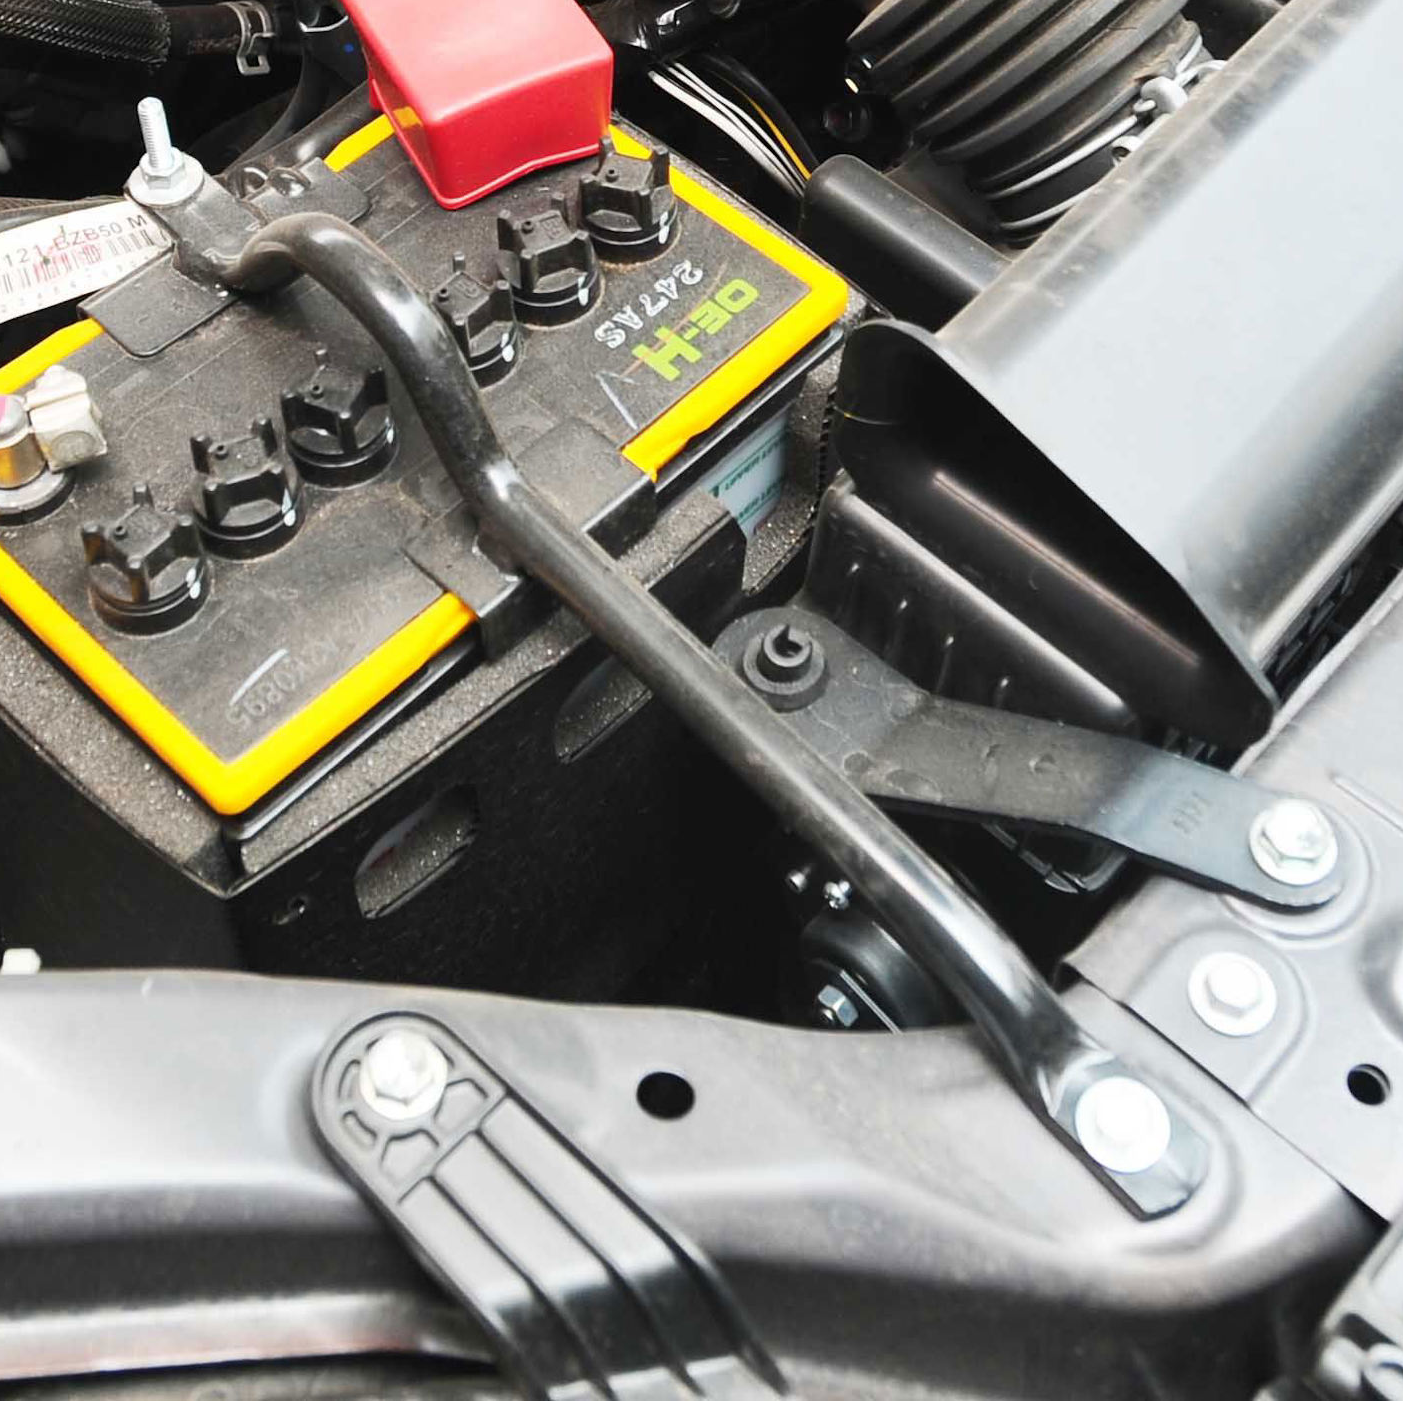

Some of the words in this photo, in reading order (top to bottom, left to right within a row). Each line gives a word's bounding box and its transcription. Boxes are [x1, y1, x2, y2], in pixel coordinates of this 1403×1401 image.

[127, 214, 148, 228] M
[595, 259, 704, 350] 247AS
[631, 278, 759, 382] OE-H
